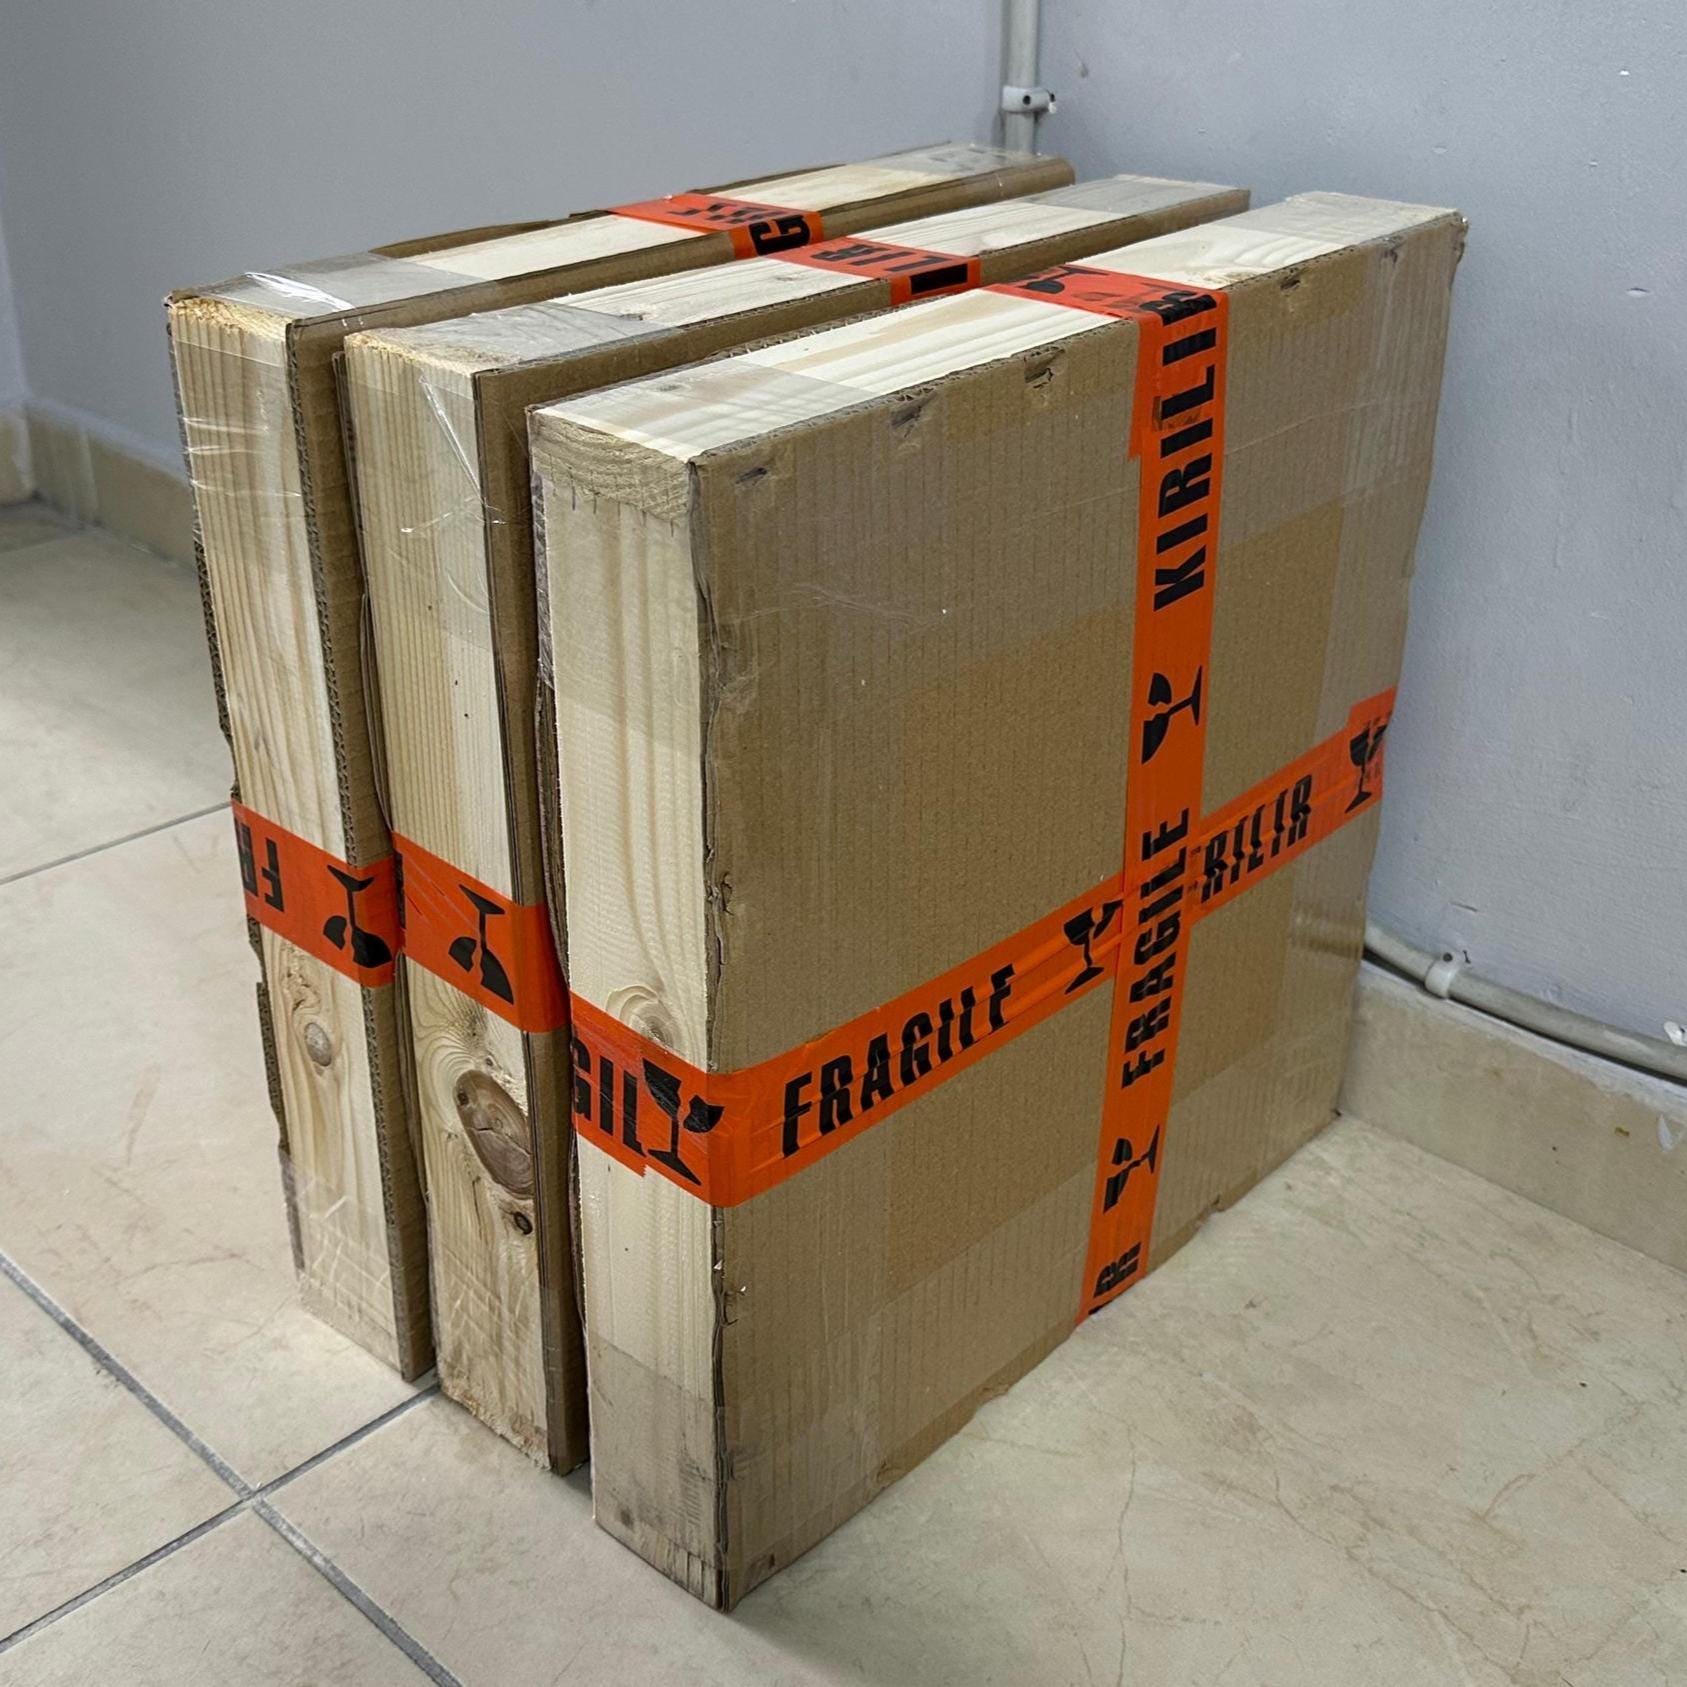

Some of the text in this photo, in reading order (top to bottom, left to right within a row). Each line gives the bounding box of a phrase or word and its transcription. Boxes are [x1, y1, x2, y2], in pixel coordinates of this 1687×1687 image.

[810, 243, 969, 295] ILIR
[1139, 290, 1218, 613] KIRILIR
[1200, 774, 1313, 904] RILIR
[1121, 807, 1190, 1089] FRAGILE
